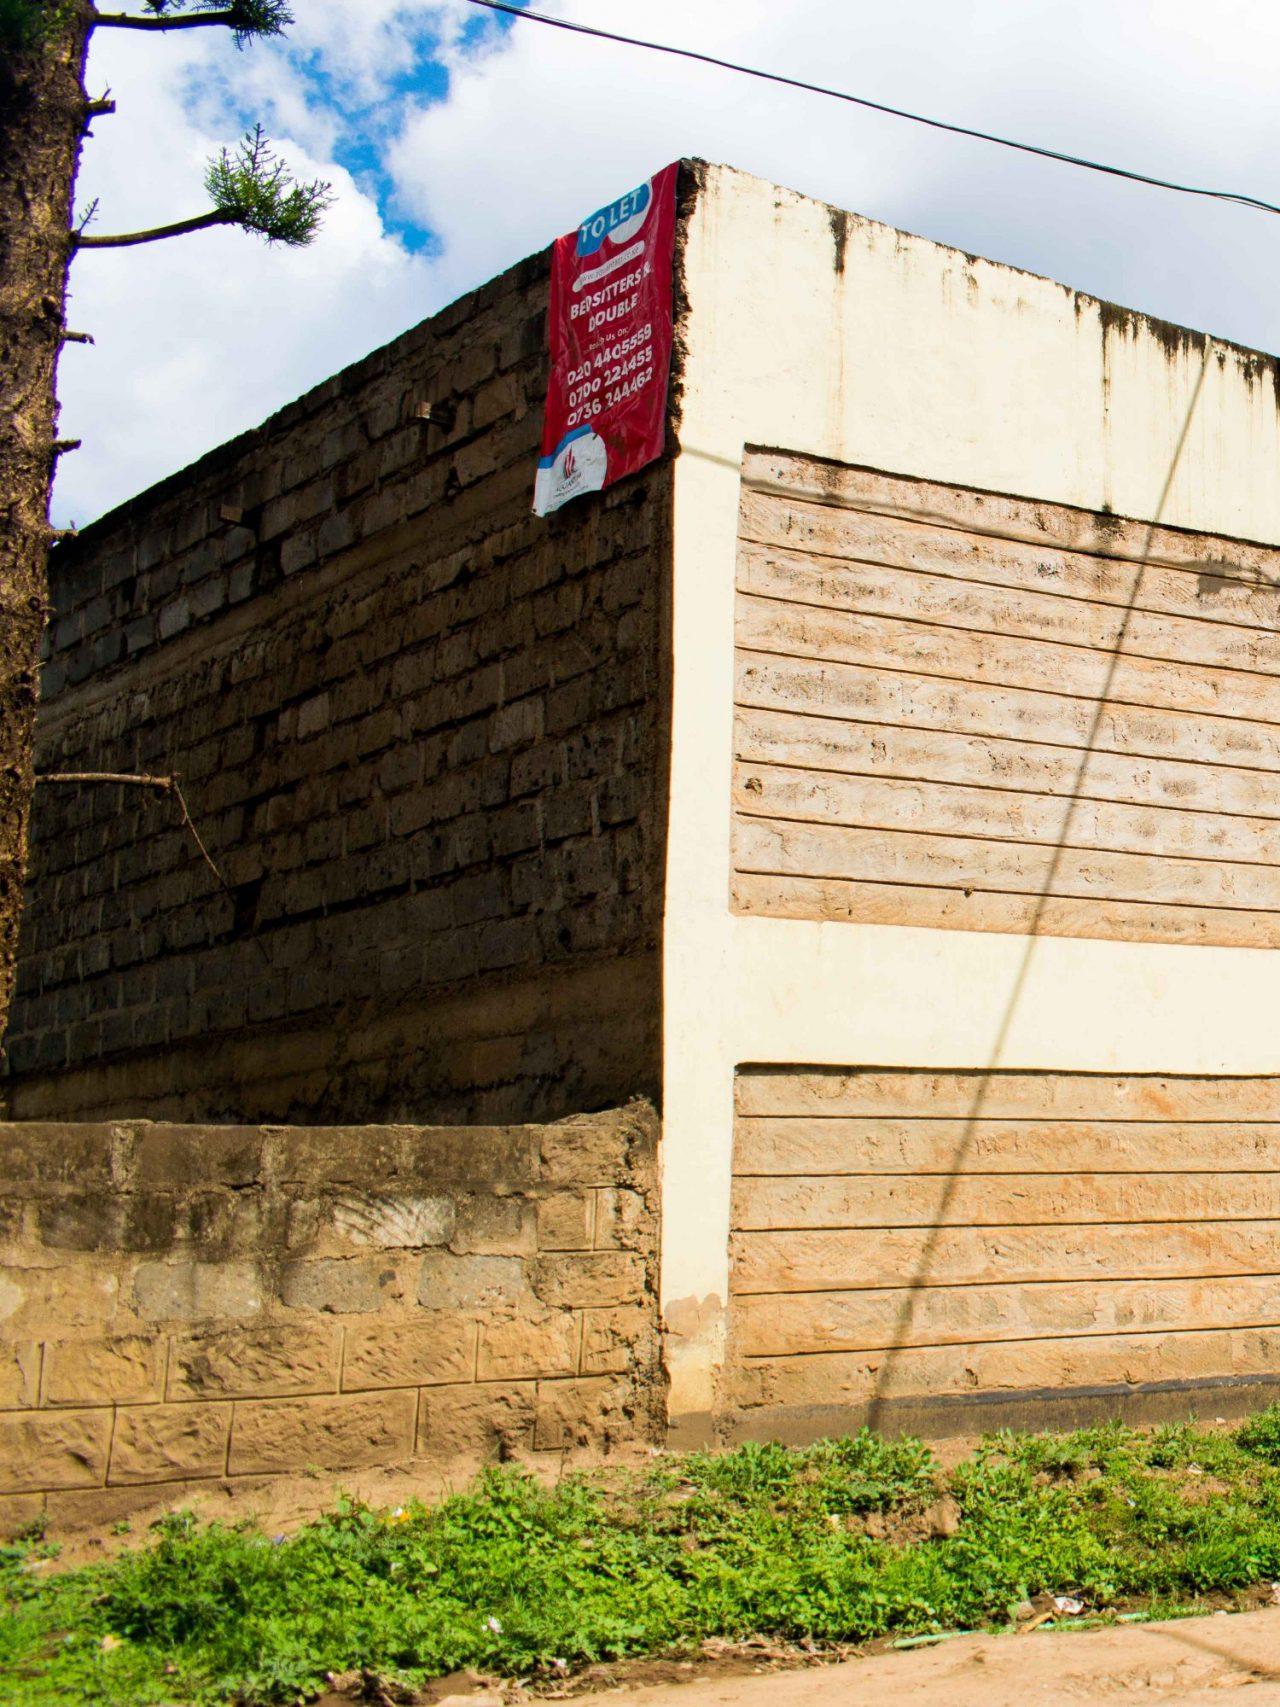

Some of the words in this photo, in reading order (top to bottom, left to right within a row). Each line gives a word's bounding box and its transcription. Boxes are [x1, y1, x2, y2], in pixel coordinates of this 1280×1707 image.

[581, 215, 605, 243] TO
[610, 189, 641, 226] LET
[570, 268, 642, 320] BEDSITTERS
[588, 293, 639, 332] DOUBLE
[567, 361, 591, 385] 020
[594, 323, 652, 367] 4405559
[569, 378, 602, 407] 0700
[604, 345, 653, 387] 224455
[567, 398, 602, 426] 0736
